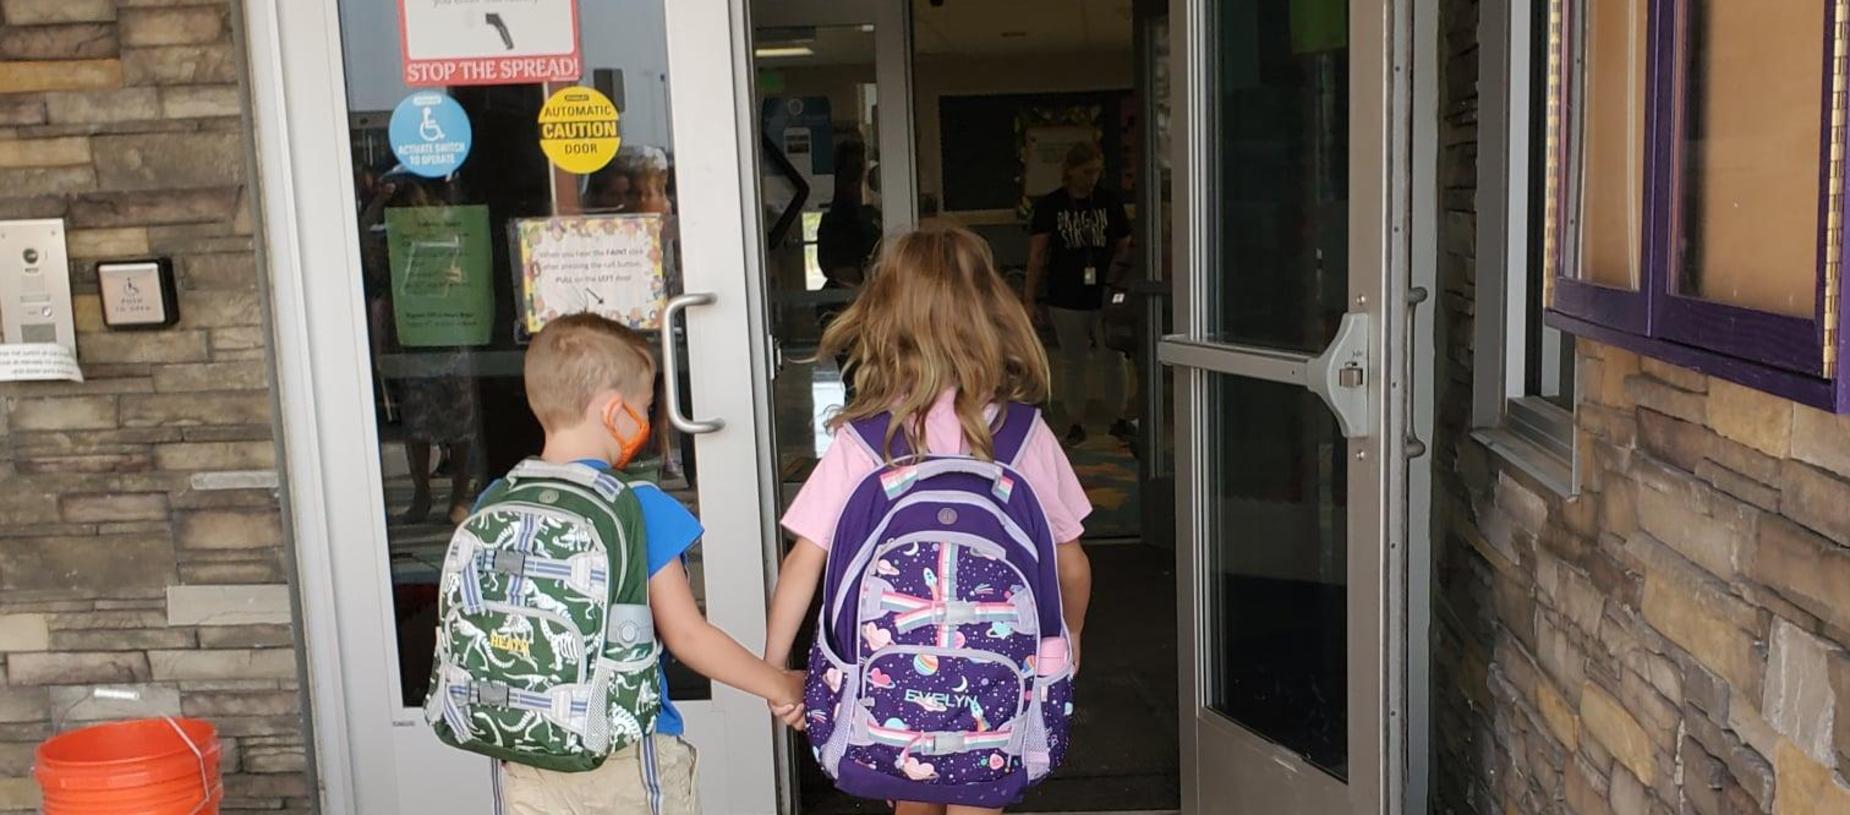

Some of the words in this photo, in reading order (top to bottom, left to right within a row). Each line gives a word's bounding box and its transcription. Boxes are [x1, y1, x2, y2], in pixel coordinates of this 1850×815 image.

[407, 62, 456, 82] STOP
[459, 60, 497, 80] THE
[499, 56, 579, 79] SPREAD!
[544, 104, 613, 118] AUTOMATIC
[542, 120, 617, 139] CAUTION
[399, 143, 433, 155] ACTIVATE
[435, 142, 466, 153] SWITCH
[564, 143, 598, 155] DOOR
[410, 154, 421, 165] TO
[421, 152, 456, 165] OPERATE
[606, 248, 628, 257] FAINT
[598, 274, 614, 283] LEFT
[490, 634, 530, 654] HEATH
[904, 688, 979, 708] EVELYN
